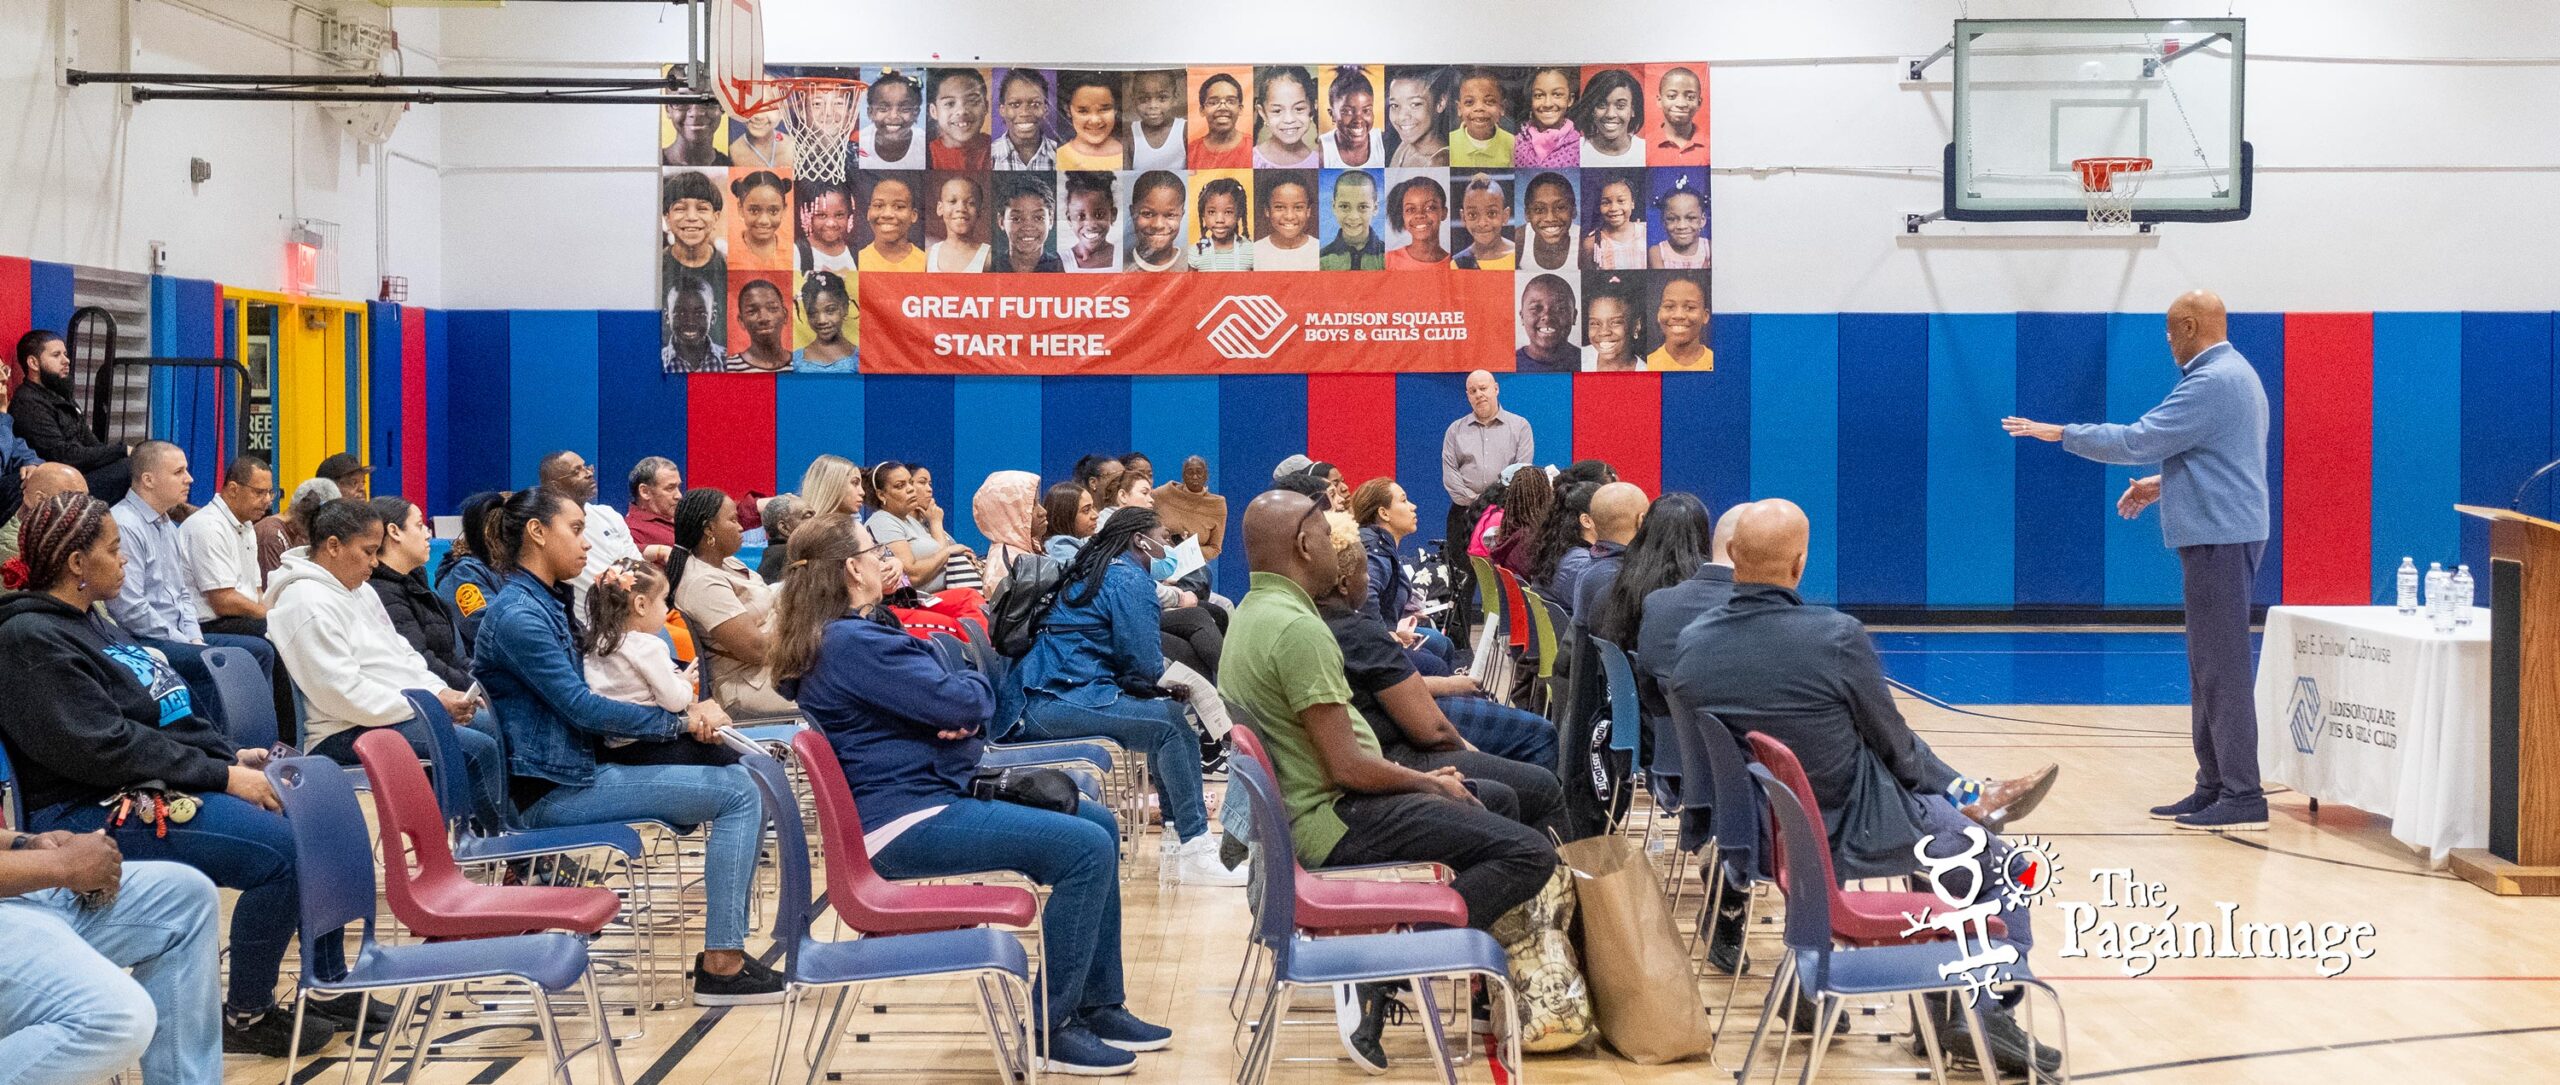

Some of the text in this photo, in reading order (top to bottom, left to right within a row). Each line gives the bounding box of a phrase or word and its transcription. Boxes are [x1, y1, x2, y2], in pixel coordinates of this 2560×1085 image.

[902, 296, 1130, 318] GREAT FUTURES
[1305, 312, 1464, 327] MADISON SQUARE
[1305, 327, 1467, 341] BOYS & GIRLS CLUB
[933, 333, 1111, 356] START HERE.
[2345, 723, 2354, 739] &
